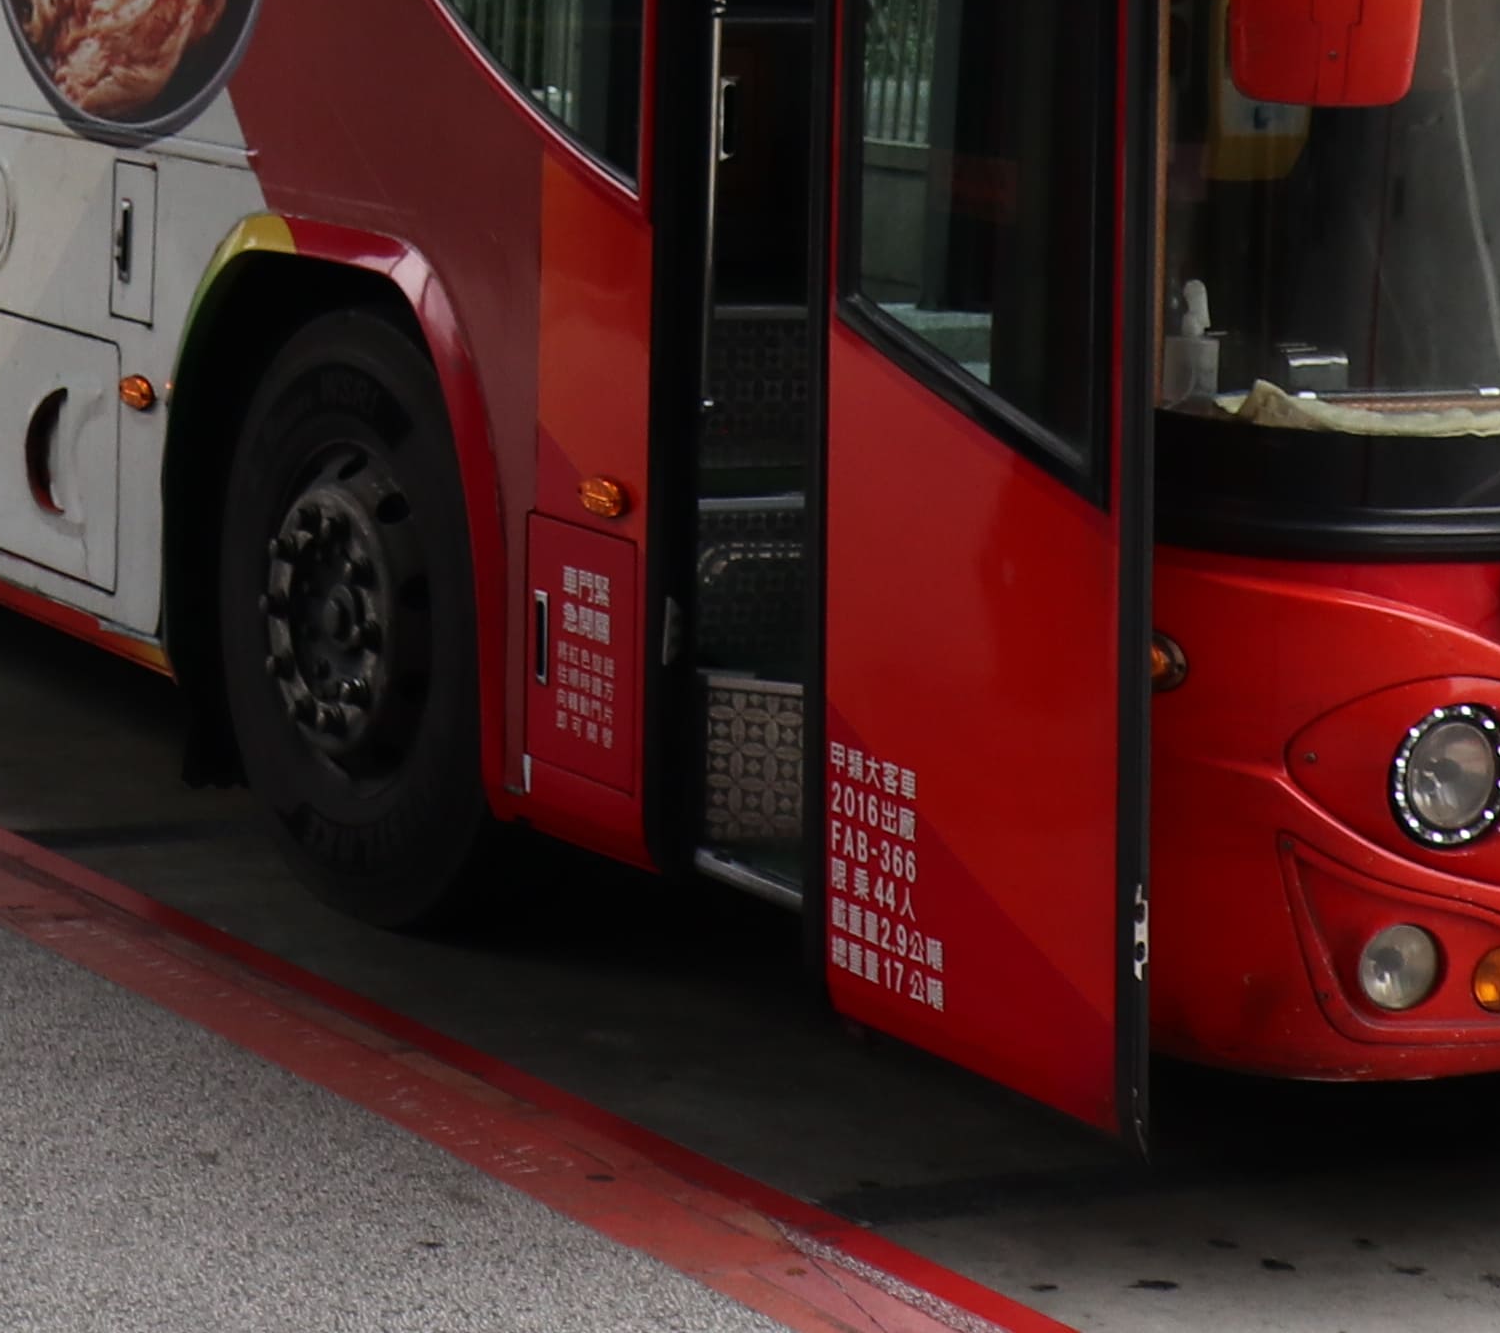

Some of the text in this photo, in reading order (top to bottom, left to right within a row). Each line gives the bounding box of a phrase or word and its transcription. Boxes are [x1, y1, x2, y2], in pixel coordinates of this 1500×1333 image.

[829, 741, 917, 801] 甲類大客車
[830, 820, 917, 883] FAB-366
